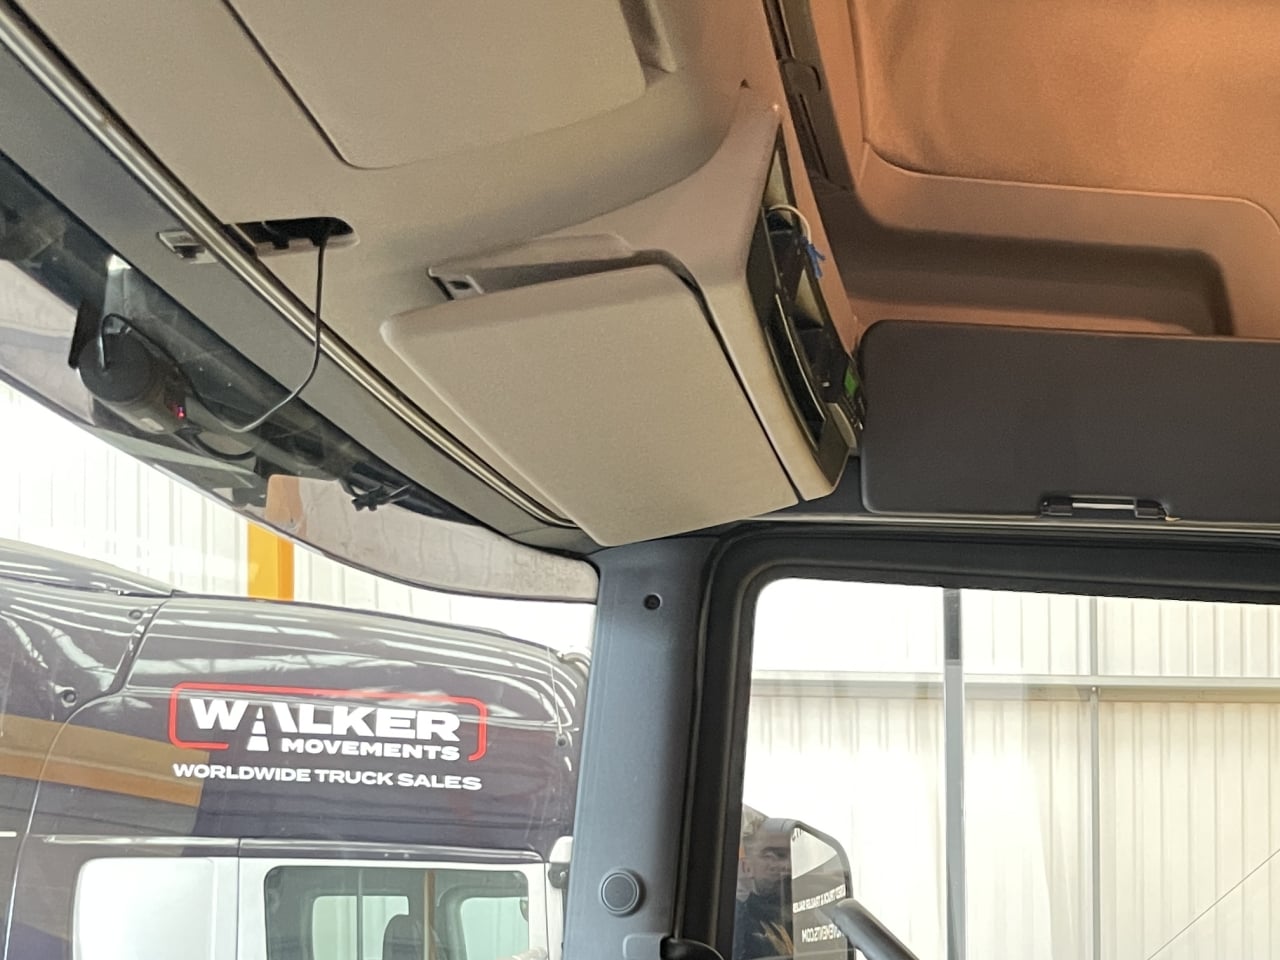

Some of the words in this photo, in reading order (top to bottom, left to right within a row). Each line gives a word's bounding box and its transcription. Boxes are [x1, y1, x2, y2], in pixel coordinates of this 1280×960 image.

[190, 698, 460, 751] WALKER
[281, 738, 460, 761] MOVEMENTS
[173, 764, 310, 783] WORLDWIDE
[315, 768, 394, 787] TRUCK
[397, 773, 482, 791] SALES
